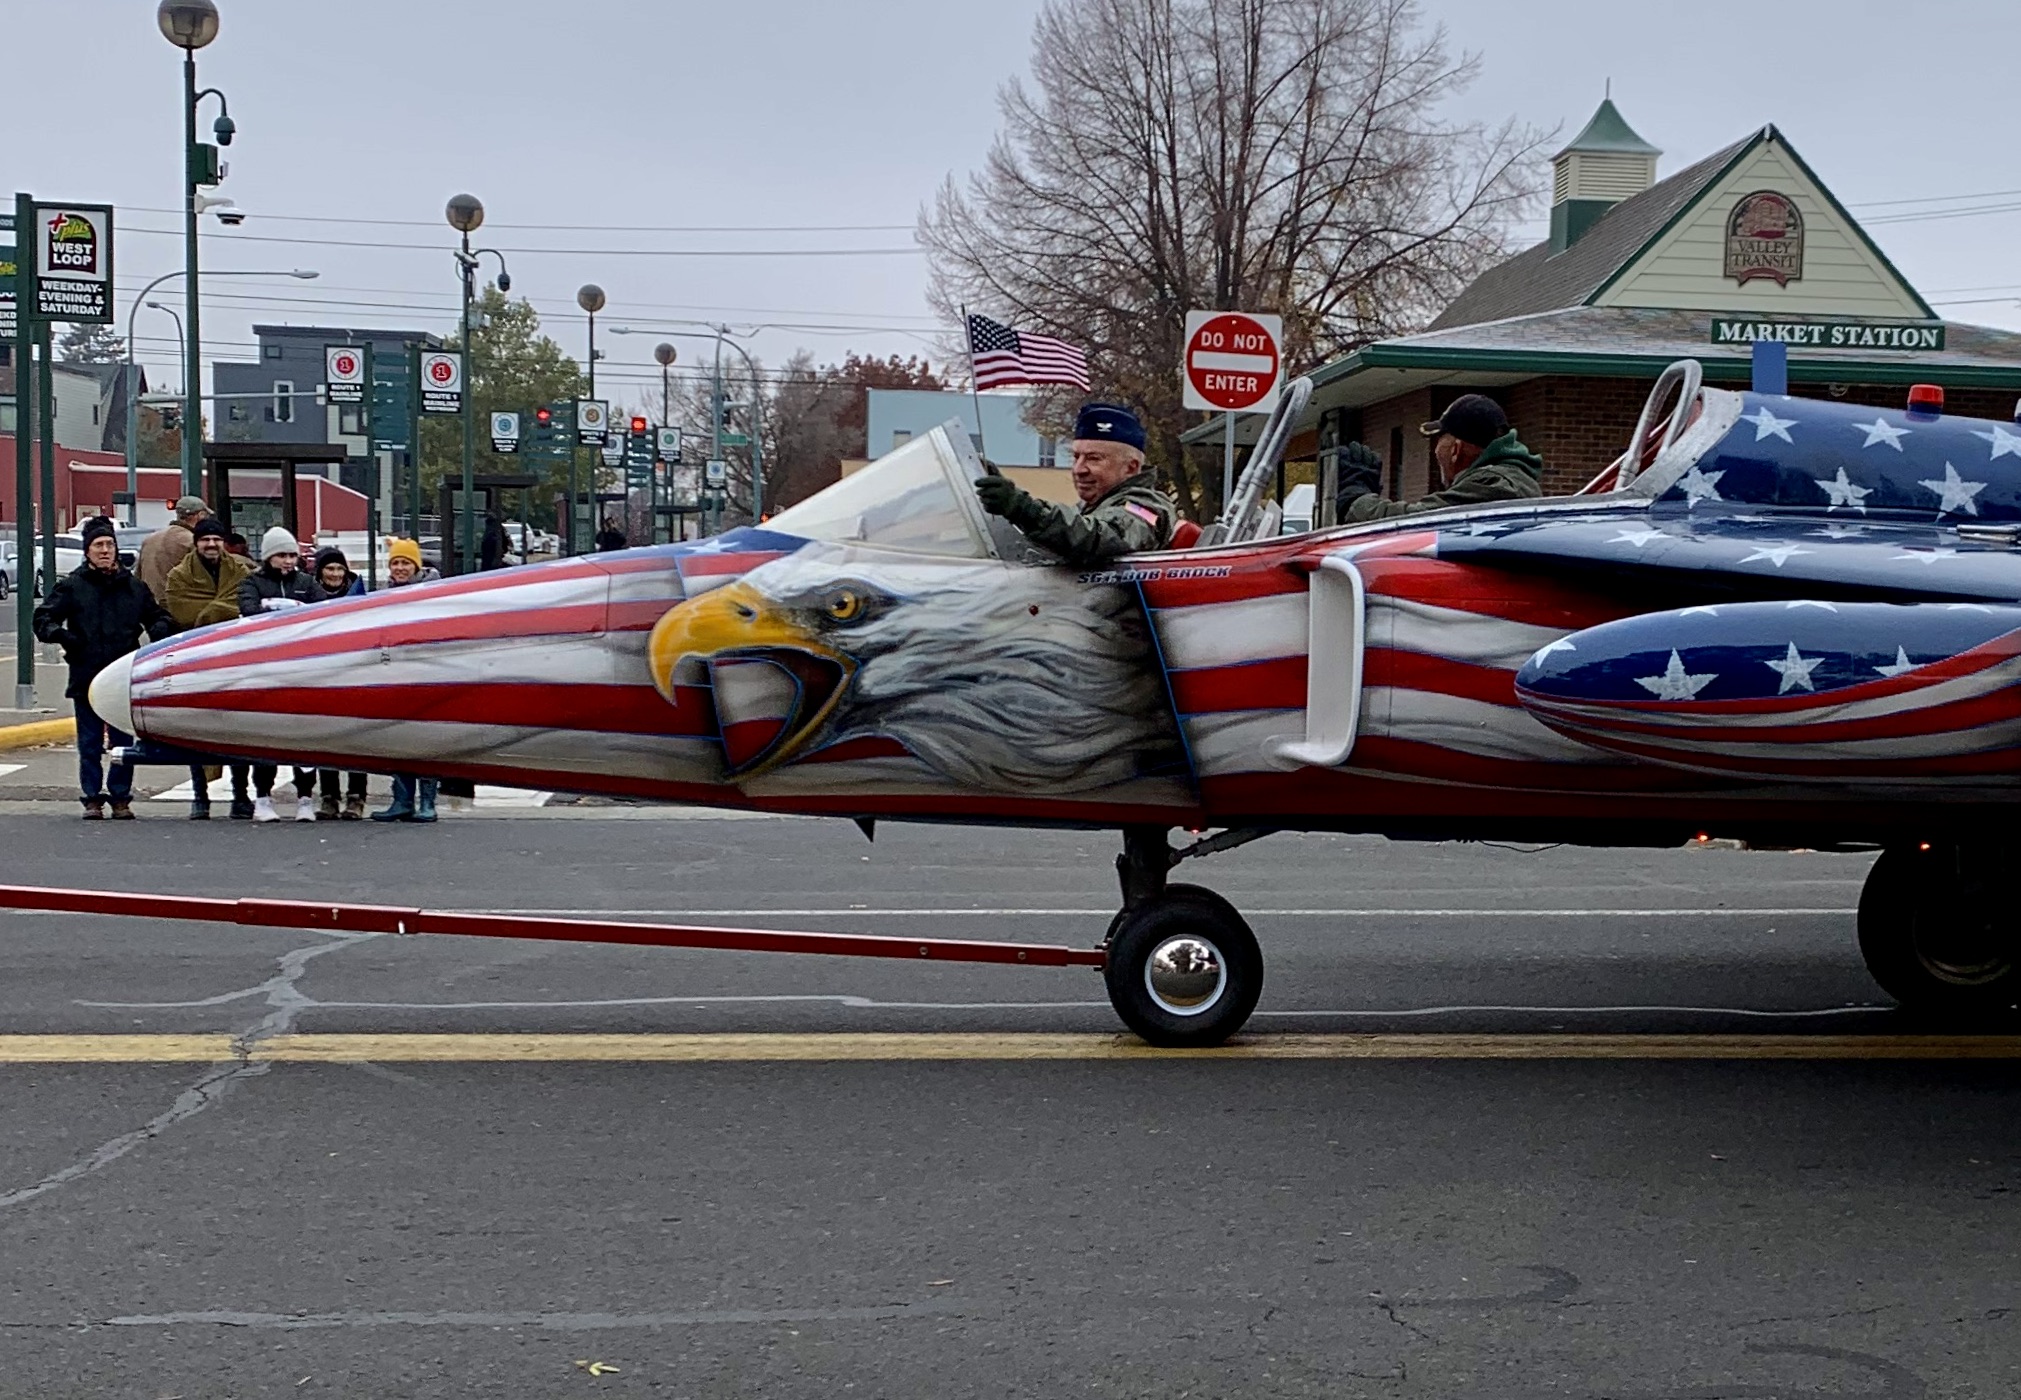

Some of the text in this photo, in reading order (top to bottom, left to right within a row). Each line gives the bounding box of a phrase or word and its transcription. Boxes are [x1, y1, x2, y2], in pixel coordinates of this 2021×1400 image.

[60, 221, 91, 241] plus
[52, 241, 93, 254] WEST
[1738, 240, 1792, 254] VALLEY
[53, 253, 92, 266] LOOP
[1731, 253, 1796, 268] TRANSIT
[39, 291, 104, 305] EVENING &
[40, 302, 102, 315] SATURDAY
[1201, 331, 1267, 351] DO NOT
[1718, 322, 1938, 348] MARKET STATION
[340, 359, 351, 371] 1
[435, 365, 447, 379] 1
[1205, 374, 1258, 393] ENTER
[1120, 568, 1162, 582] BOB
[1166, 565, 1233, 580] BROCK
